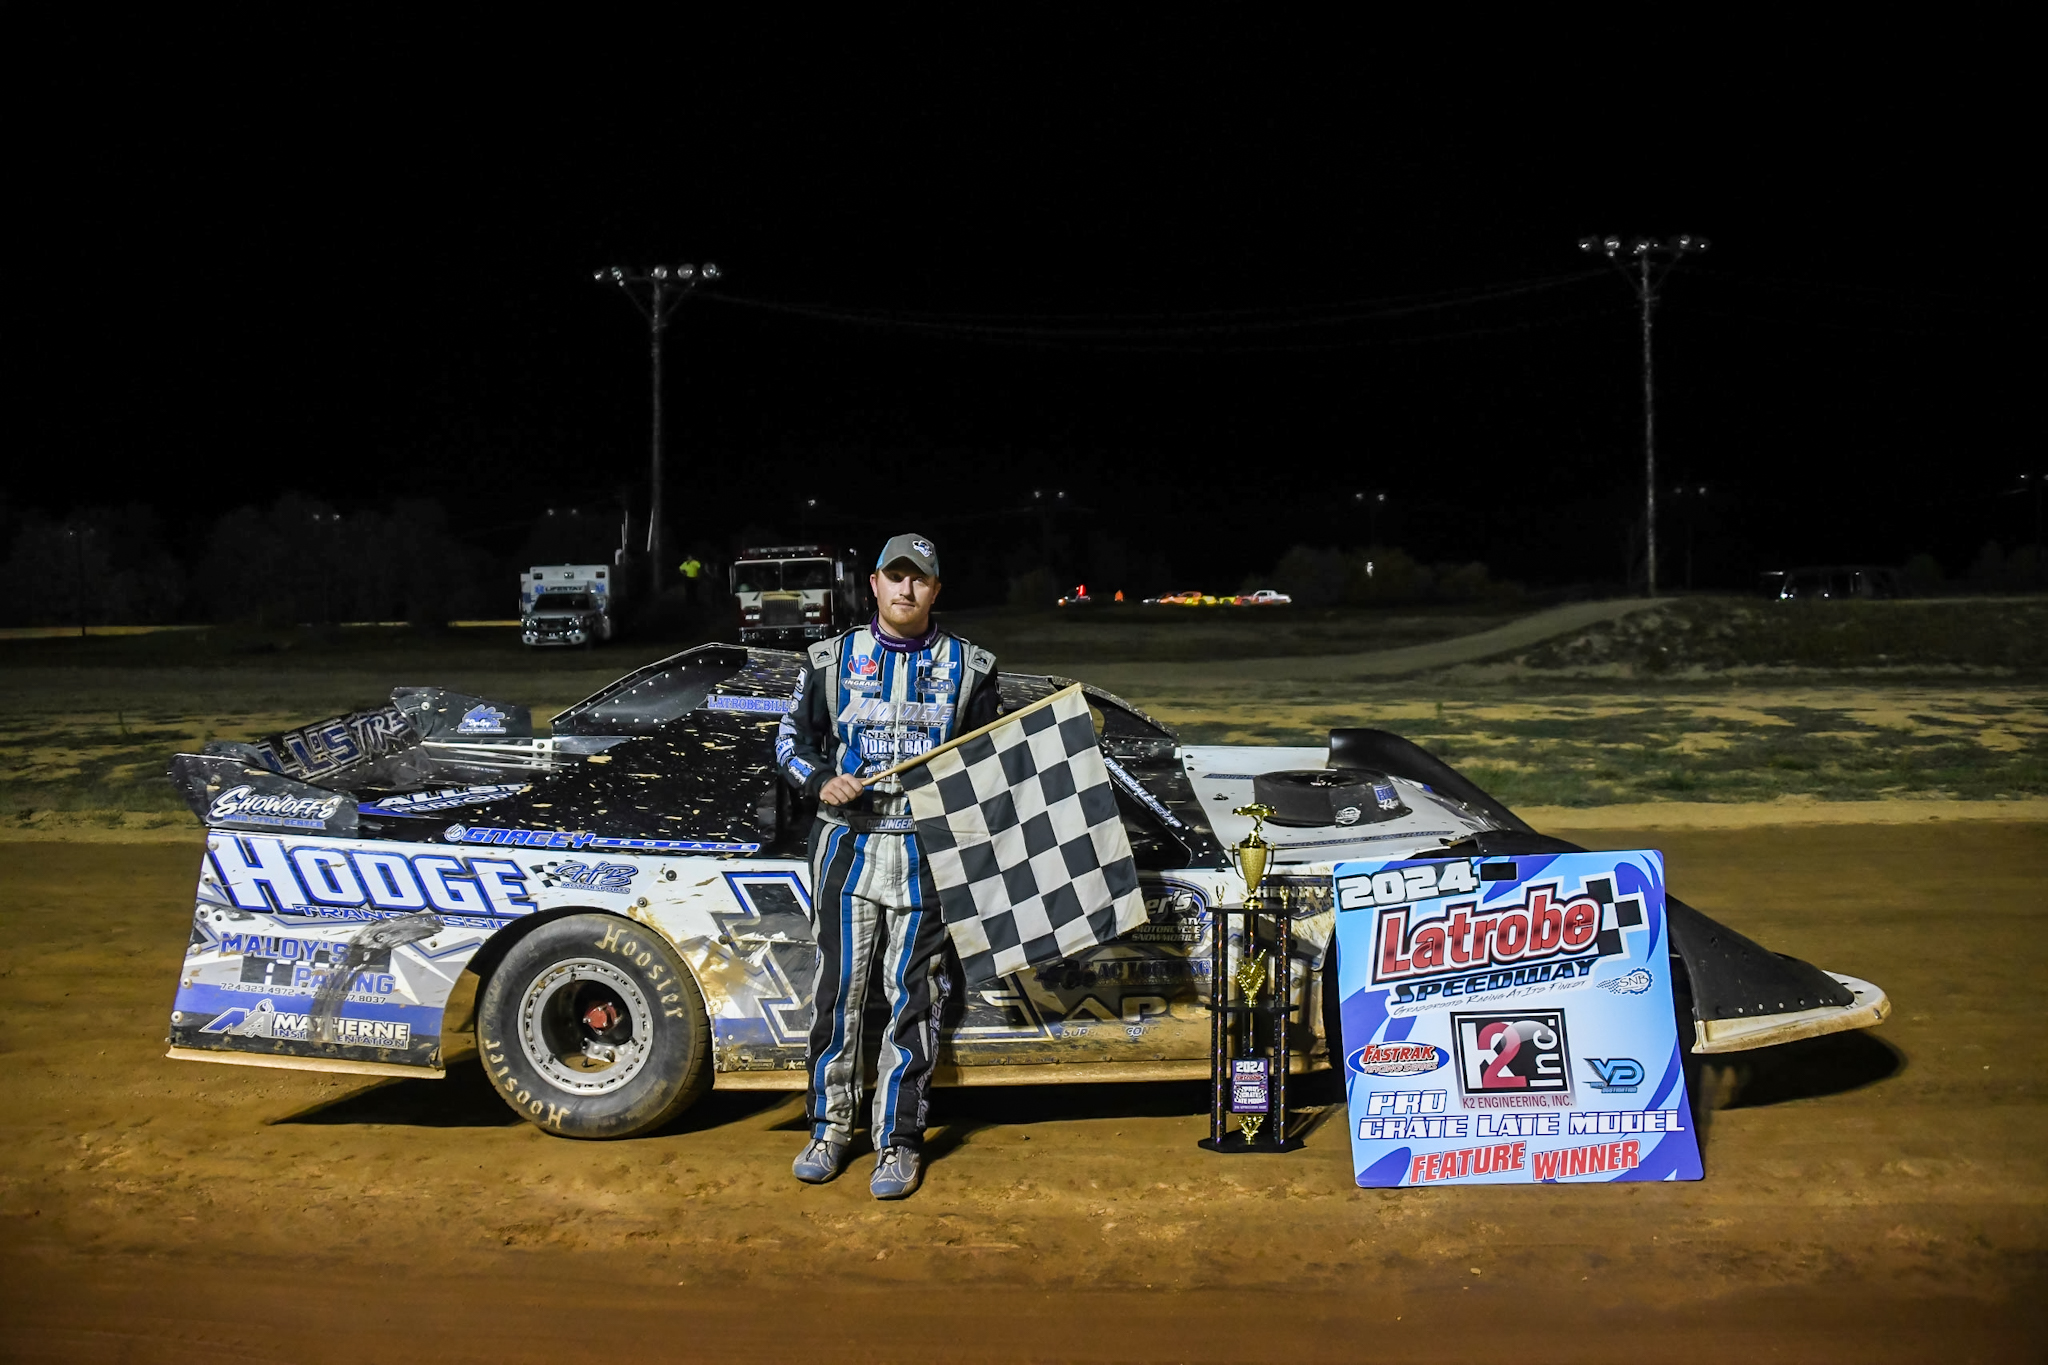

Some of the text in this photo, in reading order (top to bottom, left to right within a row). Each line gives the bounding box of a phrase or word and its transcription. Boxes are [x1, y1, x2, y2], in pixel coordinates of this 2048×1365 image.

[838, 698, 955, 723] HODGE
[462, 827, 759, 852] GNAGEY PROPANE
[209, 833, 538, 918] HODGE
[1338, 861, 1480, 911] 2024
[219, 931, 352, 963] MALOY'S
[1380, 888, 1599, 977] Latrobe
[1390, 958, 1598, 1005] SPEEDWAY
[1236, 1061, 1264, 1073] 2024
[1362, 1043, 1436, 1064] FASTRAK
[1367, 1090, 1447, 1116] PRO
[1462, 1095, 1573, 1108] K2 ENGINEERING, INC.
[1359, 1110, 1686, 1140] CRATE LATE MODEL
[1409, 1140, 1641, 1184] FEATURE WINNER
